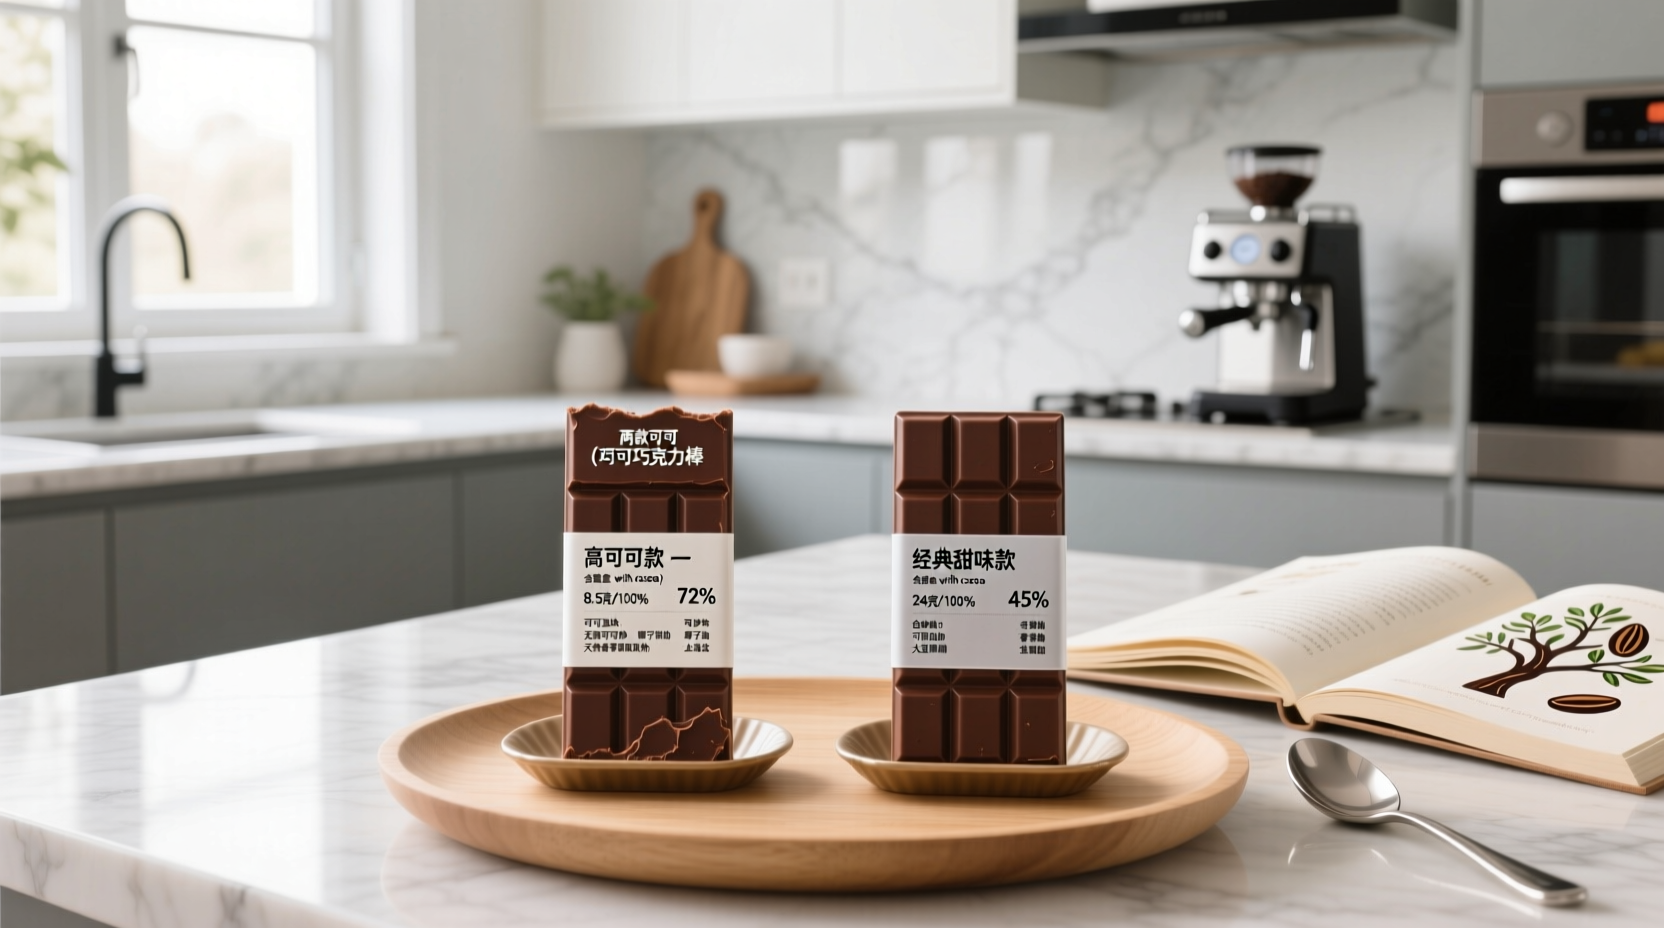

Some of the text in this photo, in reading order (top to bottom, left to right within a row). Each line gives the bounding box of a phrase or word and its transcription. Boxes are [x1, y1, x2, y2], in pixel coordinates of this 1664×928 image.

[584, 545, 664, 569] 高可可款
[912, 546, 1016, 571] 经典甜味款
[677, 587, 716, 604] 72%
[1008, 590, 1049, 608] 45%
